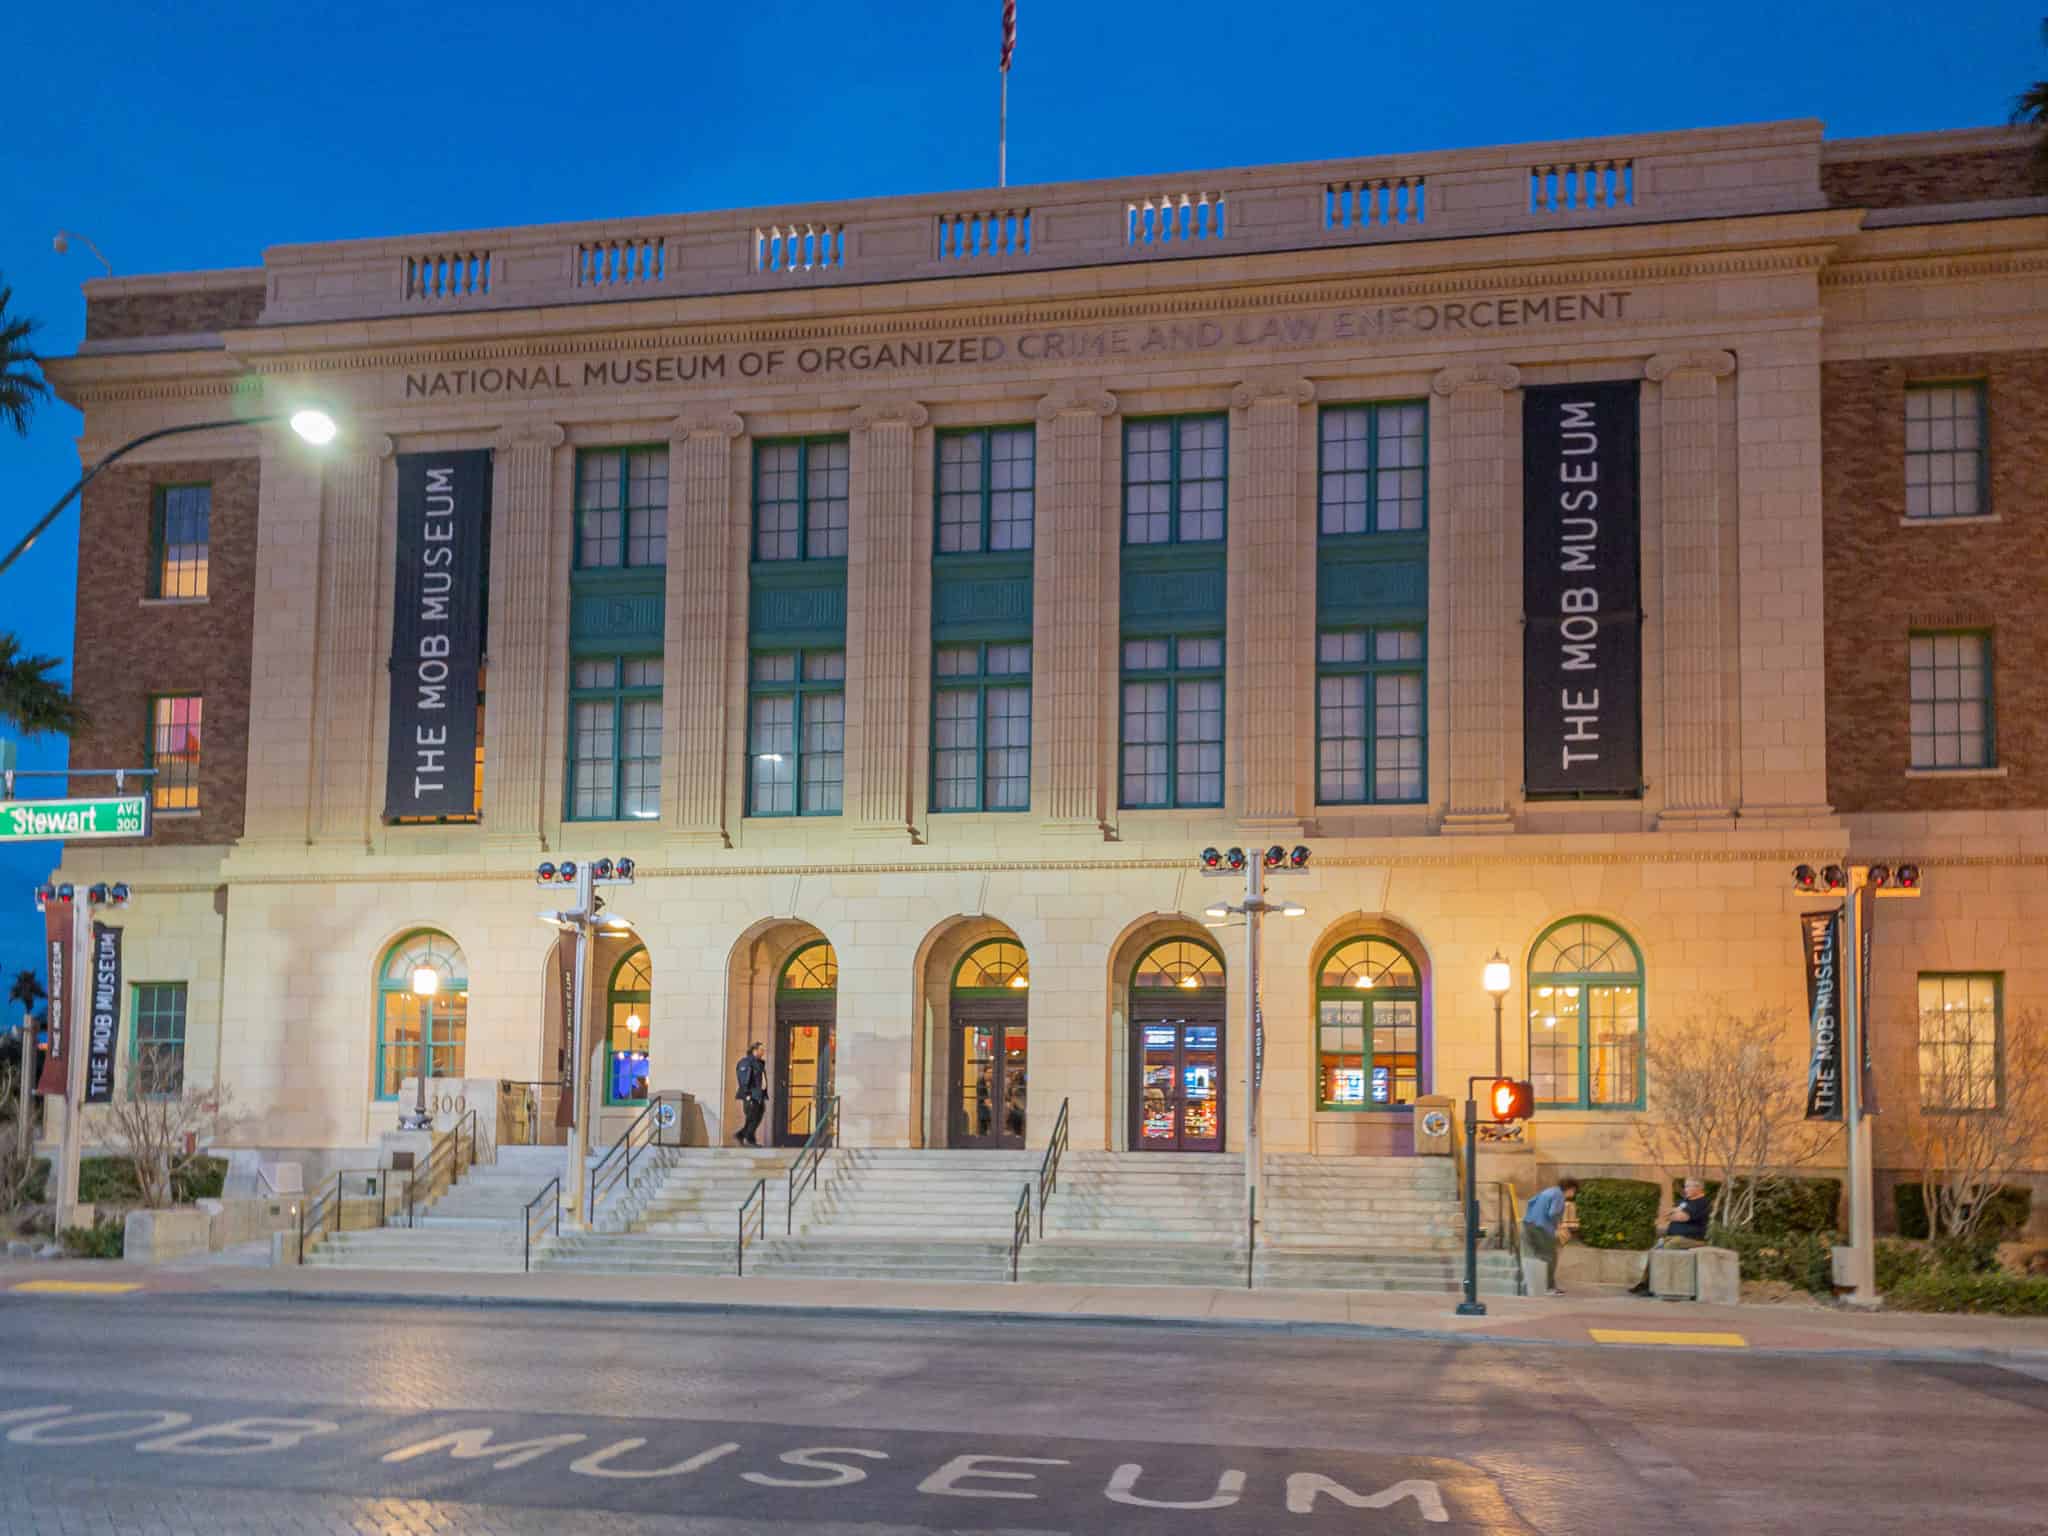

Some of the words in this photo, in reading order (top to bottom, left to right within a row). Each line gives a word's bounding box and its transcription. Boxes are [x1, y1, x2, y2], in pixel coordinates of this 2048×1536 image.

[405, 364, 571, 398] NATIONAL
[584, 353, 725, 386] MUSEUM
[738, 349, 785, 378] OF
[797, 336, 1005, 374] ORGANIZED
[1018, 328, 1128, 360] CRIME
[1141, 321, 1222, 353] AND
[1235, 312, 1317, 345] LAW
[1336, 292, 1630, 340] ENFORCEMENT
[1561, 401, 1598, 571] MUSEUM
[421, 468, 454, 621] MUSEUM
[1561, 587, 1599, 671] MOB
[418, 635, 450, 710] MOB
[414, 724, 446, 799] THE
[1562, 688, 1599, 771] THE
[13, 805, 97, 834] Stewart
[117, 801, 140, 816] AVE
[117, 818, 139, 832] 300
[95, 933, 116, 1010] MUSEUM
[1811, 919, 1834, 1010] MUSEUM
[93, 1014, 113, 1053] MOB
[1816, 1015, 1835, 1061] MOB
[91, 1057, 109, 1096] THE
[1814, 1066, 1836, 1111] THE
[381, 1427, 1450, 1522] MUSEUM
